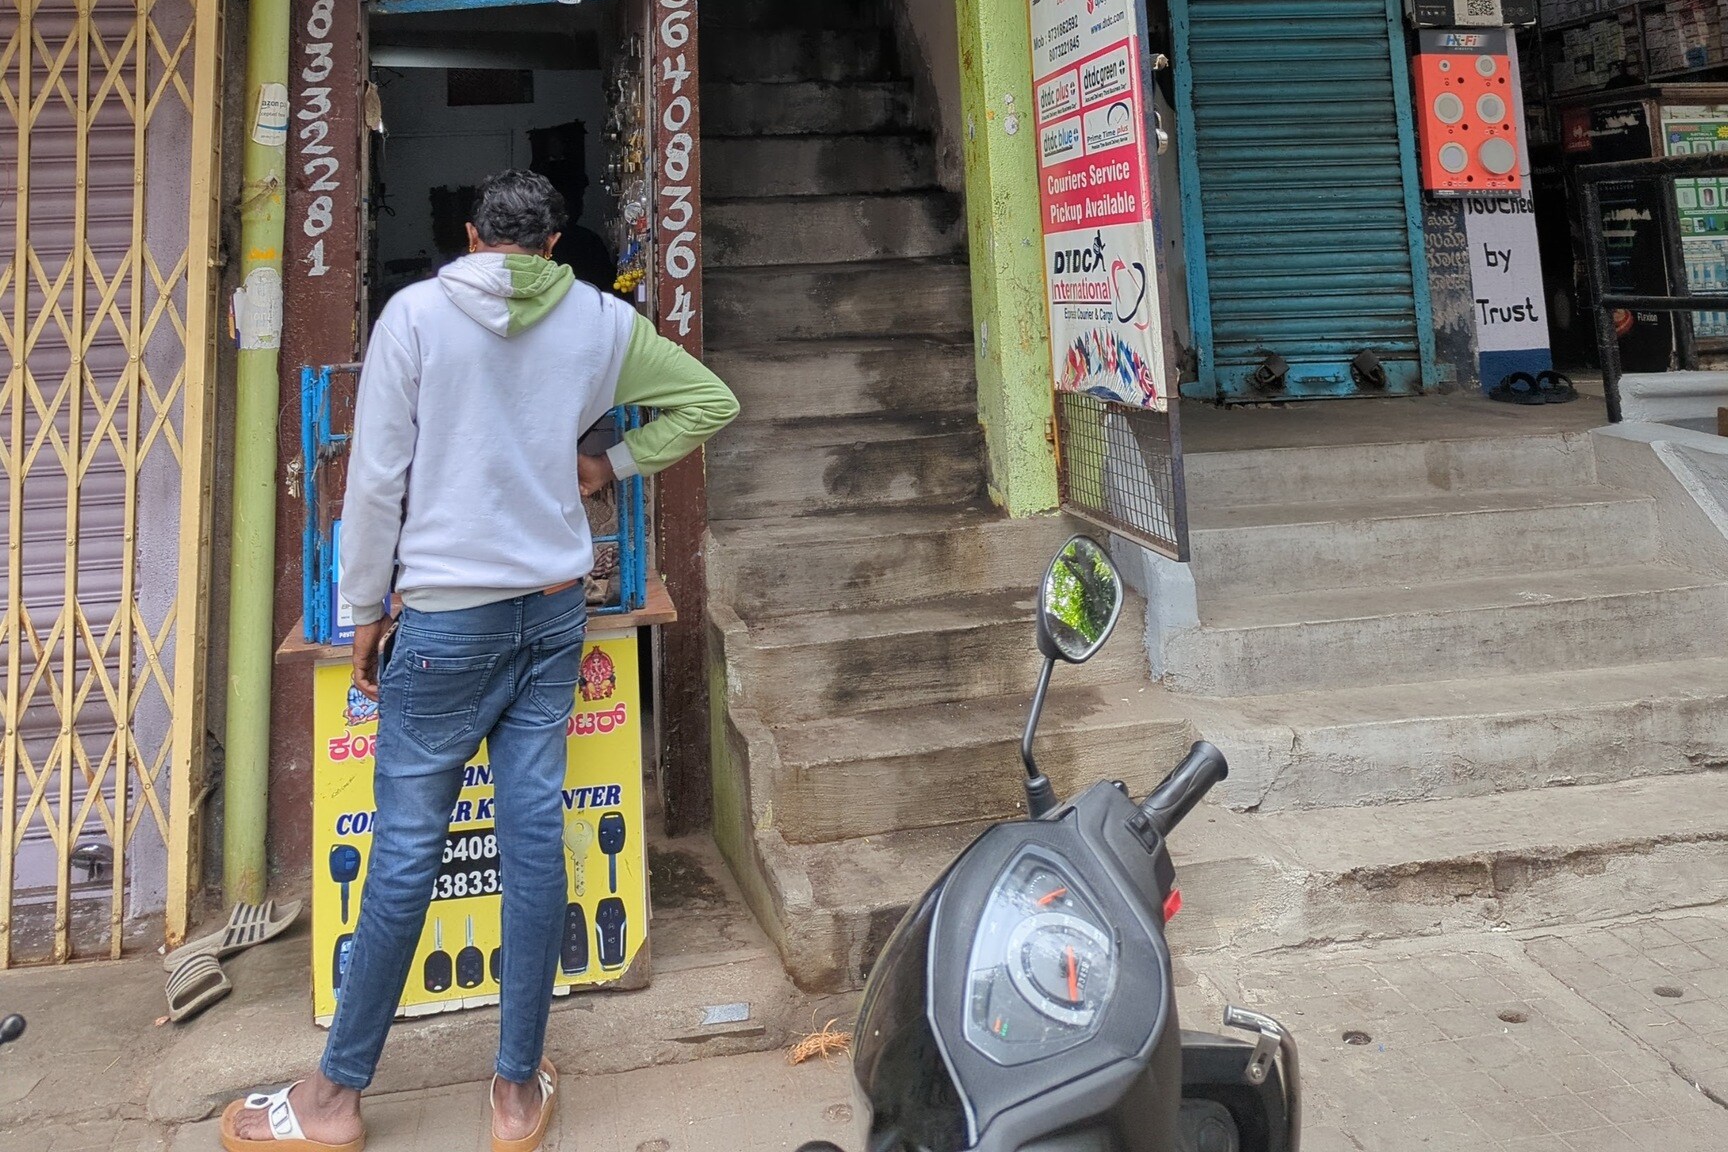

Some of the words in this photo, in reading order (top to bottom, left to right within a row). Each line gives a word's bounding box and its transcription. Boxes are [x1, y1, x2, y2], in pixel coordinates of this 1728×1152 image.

[1090, 10, 1125, 35] www.dtdc.com
[1055, 81, 1069, 106] plus
[1058, 128, 1073, 147] blue
[1047, 170, 1087, 196] Couriers
[1089, 158, 1130, 186] Service
[1051, 200, 1082, 225] Pickup
[1085, 191, 1136, 218] Available
[1054, 247, 1093, 275] DTDC
[1484, 243, 1511, 273] by
[1051, 276, 1110, 302] International
[1476, 297, 1539, 325] Trust
